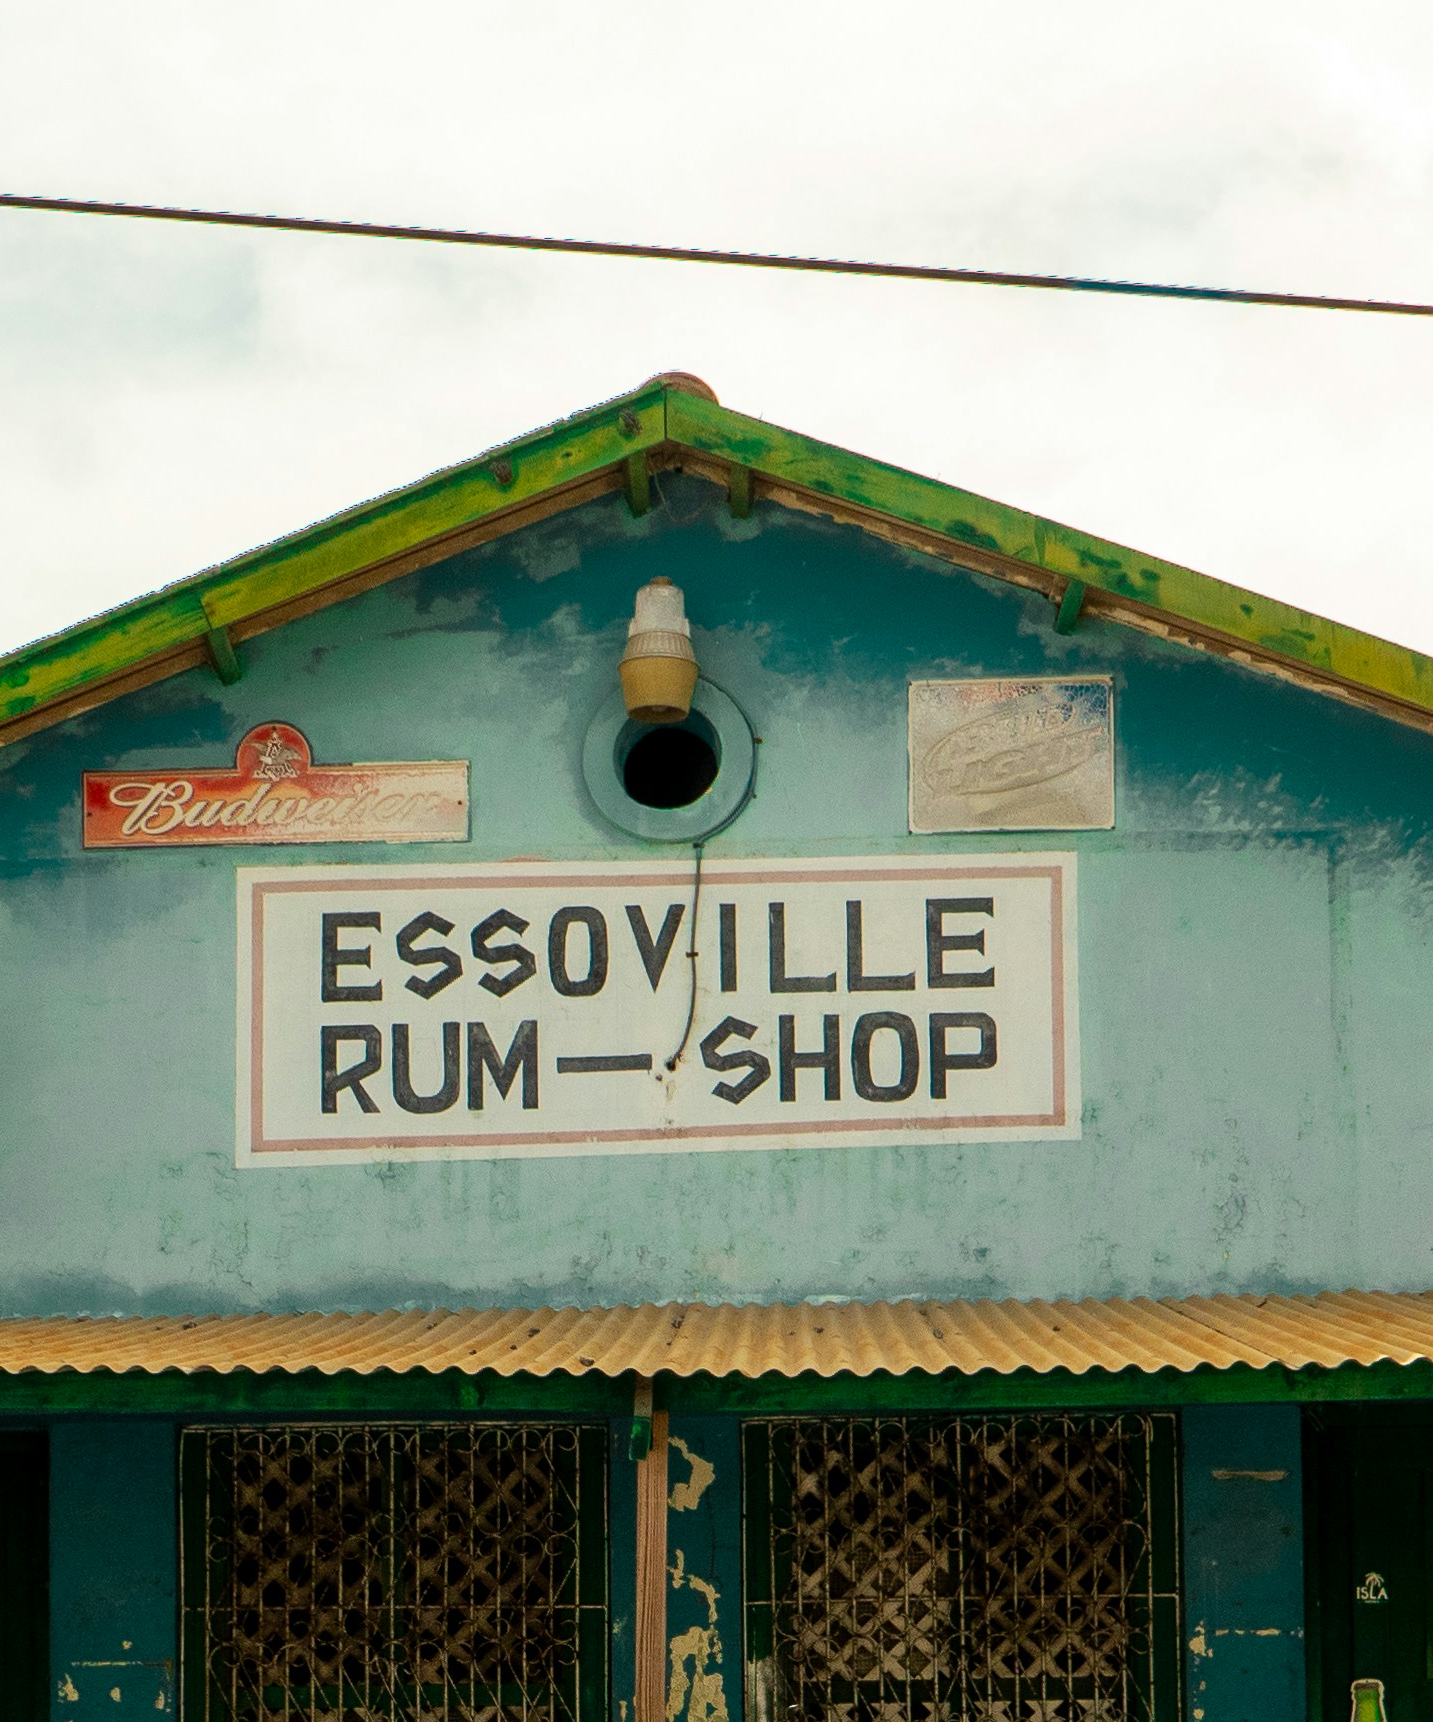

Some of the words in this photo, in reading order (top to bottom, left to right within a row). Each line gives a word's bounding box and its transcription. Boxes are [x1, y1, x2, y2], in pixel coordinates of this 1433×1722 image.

[109, 780, 439, 836] Budweiser
[321, 898, 995, 1003] ESSOVILLE
[321, 1020, 539, 1113] RUM
[699, 1011, 997, 1105] SHOP
[1355, 1586, 1389, 1601] ISLA
